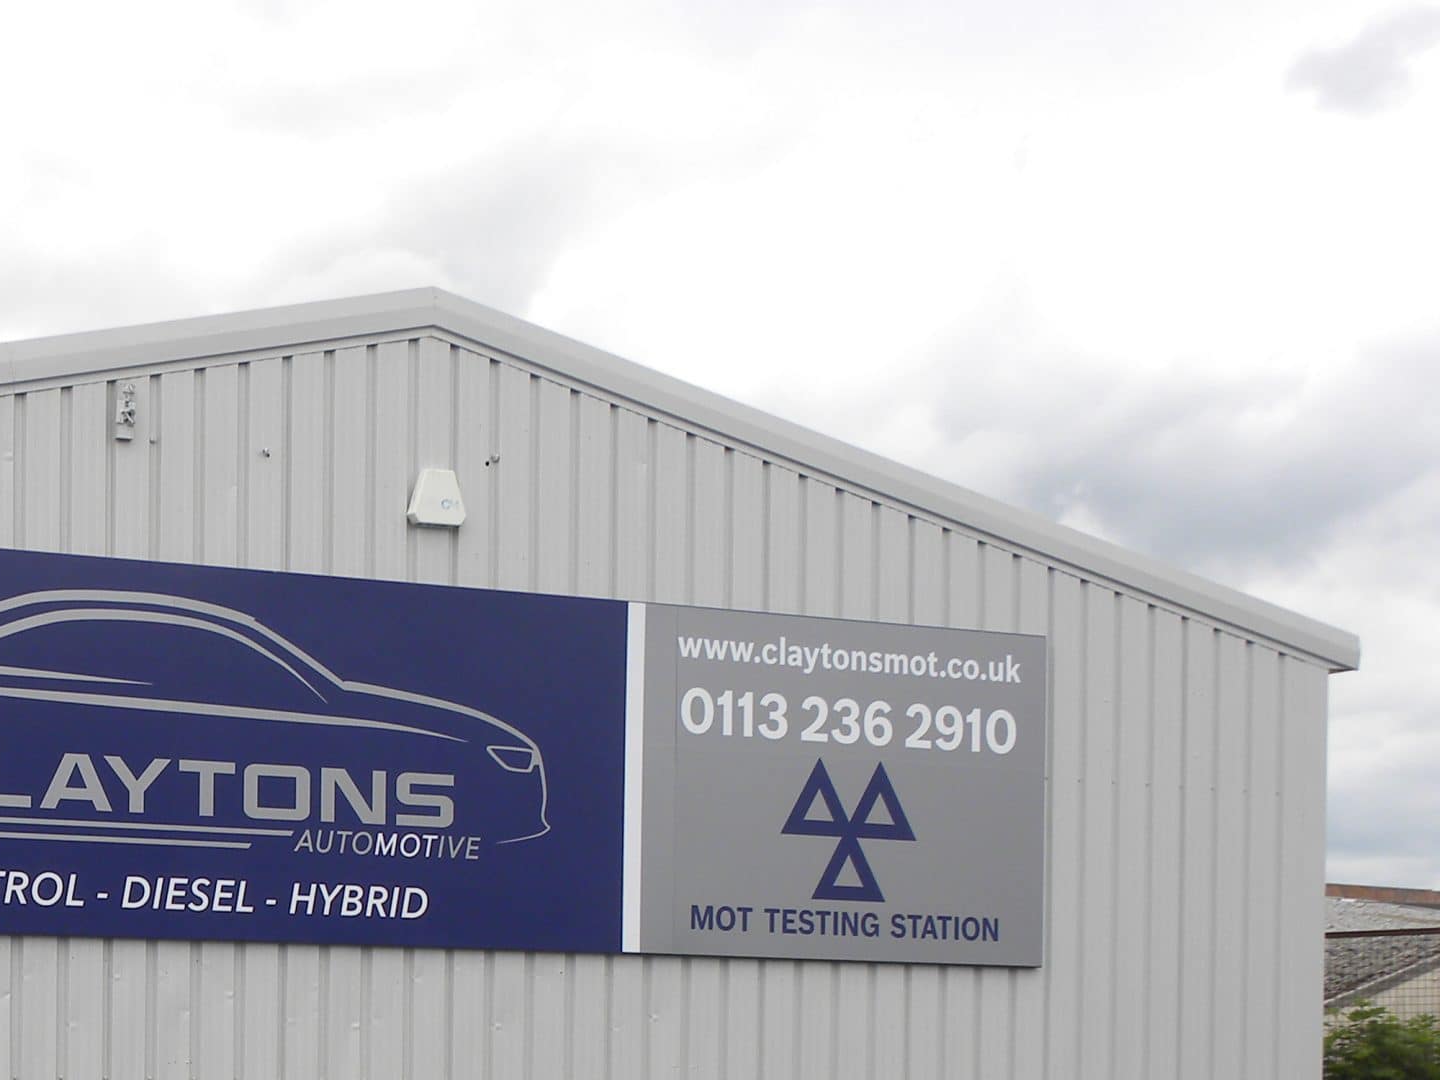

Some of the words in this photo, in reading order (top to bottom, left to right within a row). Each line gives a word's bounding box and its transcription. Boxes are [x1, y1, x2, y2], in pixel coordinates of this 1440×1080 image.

[678, 635, 1022, 683] www.claytonsmot.co.uk
[681, 687, 788, 740] 0113
[800, 696, 893, 746] 236
[905, 703, 1017, 754] 2910
[294, 829, 481, 860] AUTOMOTIVE
[121, 875, 255, 913] DIESEL
[289, 882, 429, 919] HYBRID
[690, 905, 753, 932] MOT
[765, 908, 880, 938] TESTING
[890, 914, 999, 942] STATION
